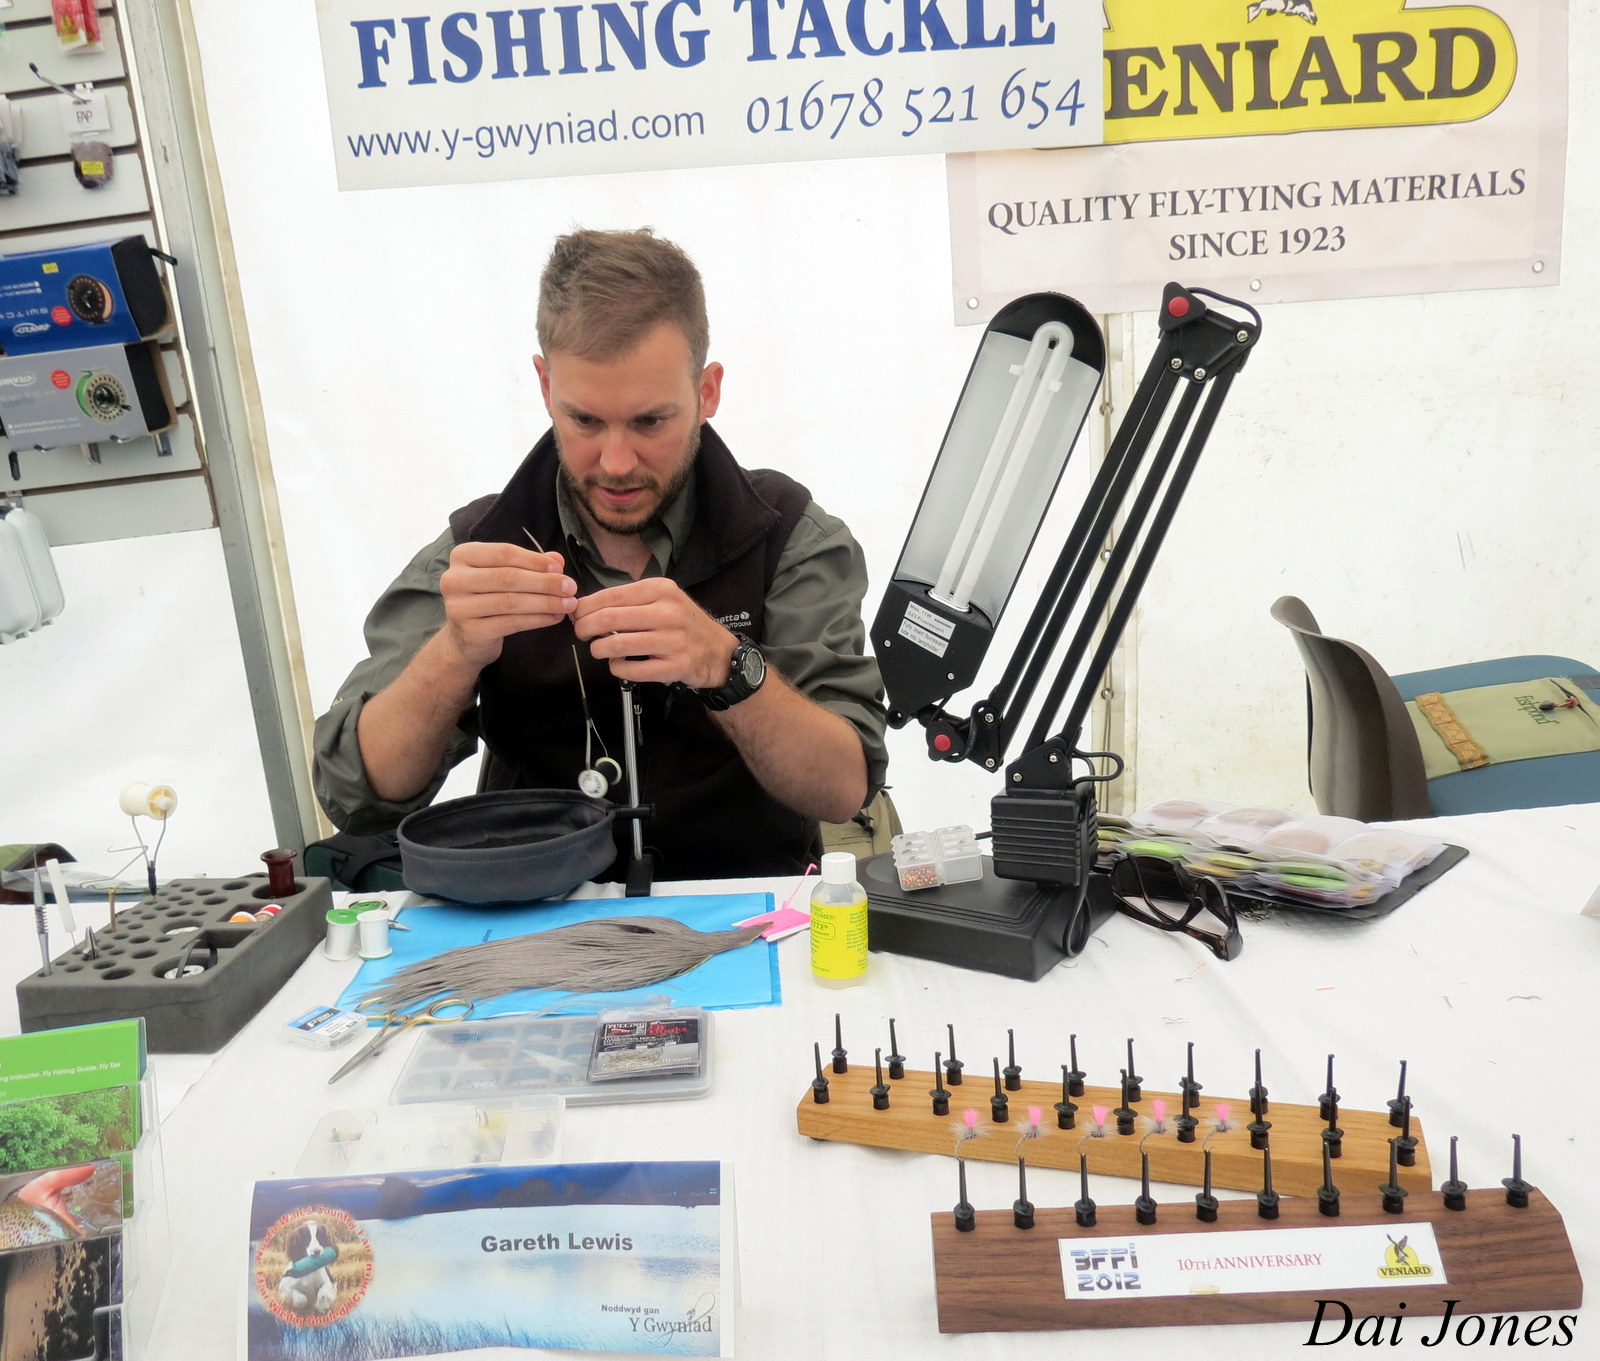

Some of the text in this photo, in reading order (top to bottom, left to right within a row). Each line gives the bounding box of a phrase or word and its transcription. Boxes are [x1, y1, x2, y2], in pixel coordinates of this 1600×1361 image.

[350, 0, 1056, 88] FISHING TACKLE
[1103, 27, 1498, 119] ENIARD
[347, 67, 1086, 160] www.y-gwyniad.com 01678 521 654
[987, 167, 1527, 236] QUALITY FLY-TYING MATERIALS
[1168, 225, 1347, 261] SINCE 1923
[316, 1204, 357, 1231] Country
[481, 1232, 633, 1253] Gareth Lewis
[1177, 1253, 1323, 1271] 10TH ANNIVERSARY
[1379, 1266, 1431, 1276] VENIARD
[1077, 1273, 1142, 1292] 2012
[601, 1304, 660, 1315] Noddwyd gan
[628, 1316, 713, 1341] Y Gwyniad
